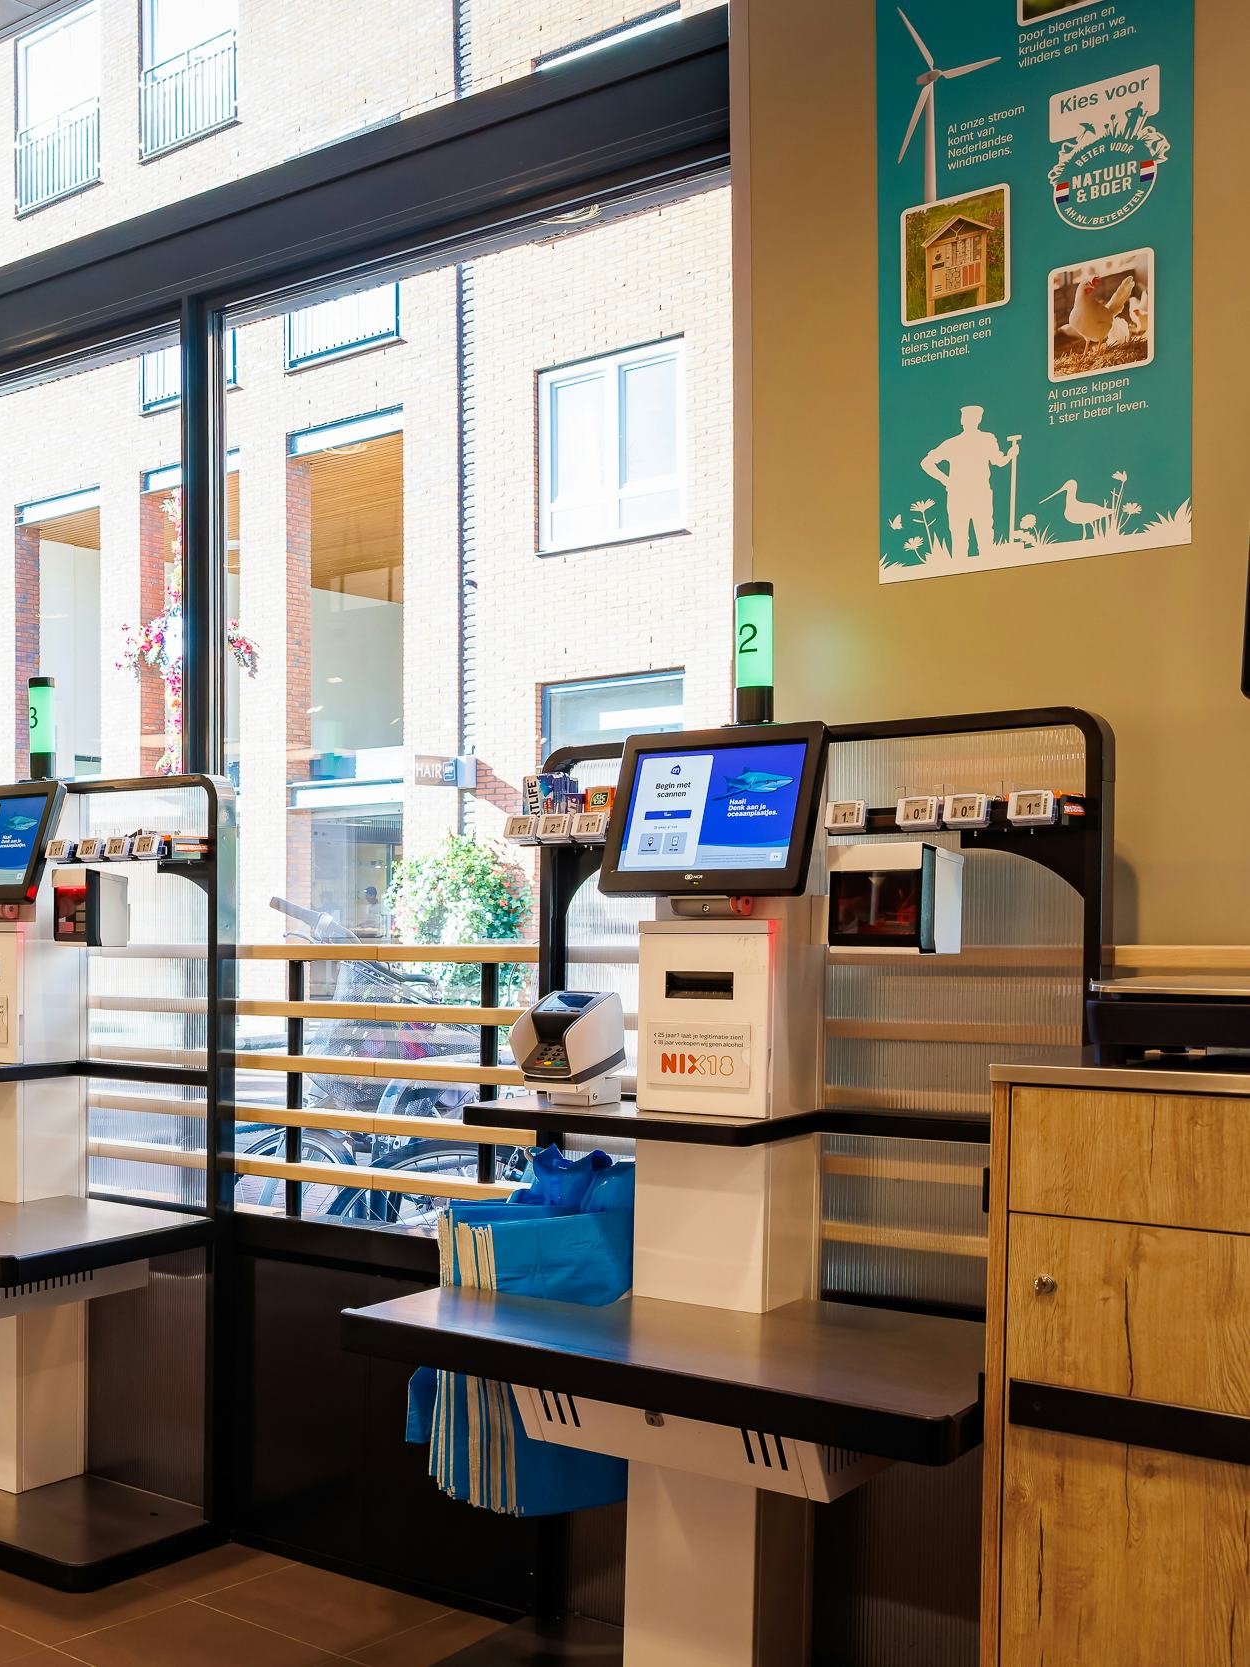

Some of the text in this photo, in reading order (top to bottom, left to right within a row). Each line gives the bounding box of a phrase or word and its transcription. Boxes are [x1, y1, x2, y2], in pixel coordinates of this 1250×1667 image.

[1018, 6, 1115, 44] Door bloemen en
[1019, 15, 1125, 56] kruiden trekken we
[1019, 25, 1137, 68] vlinders en bijen aan.
[1060, 76, 1150, 114] Kies voor
[947, 105, 1025, 135] Al onze stroom
[948, 126, 995, 146] komt van
[948, 133, 1013, 158] Nederlandse
[947, 146, 1012, 170] windmolens.
[1075, 142, 1134, 167] BETER VOOR
[1071, 160, 1137, 190] NATUUR
[1076, 177, 1132, 203] & BOER
[1064, 190, 1145, 225] AH.NL/BETERETEN
[901, 317, 991, 343] Al onze boeren en
[901, 329, 992, 355] telers hebben een
[901, 344, 970, 367] insectenhotel.
[1048, 378, 1130, 401] Al onze kippen
[1048, 390, 1122, 413] zijn minimaal
[1049, 400, 1149, 425] 1 ster beter leven.
[738, 623, 758, 654] 2
[29, 706, 38, 730] 3
[416, 763, 443, 779] HAIR
[655, 782, 675, 790] Begin
[759, 803, 767, 811] je
[661, 1052, 734, 1076] NIX18
